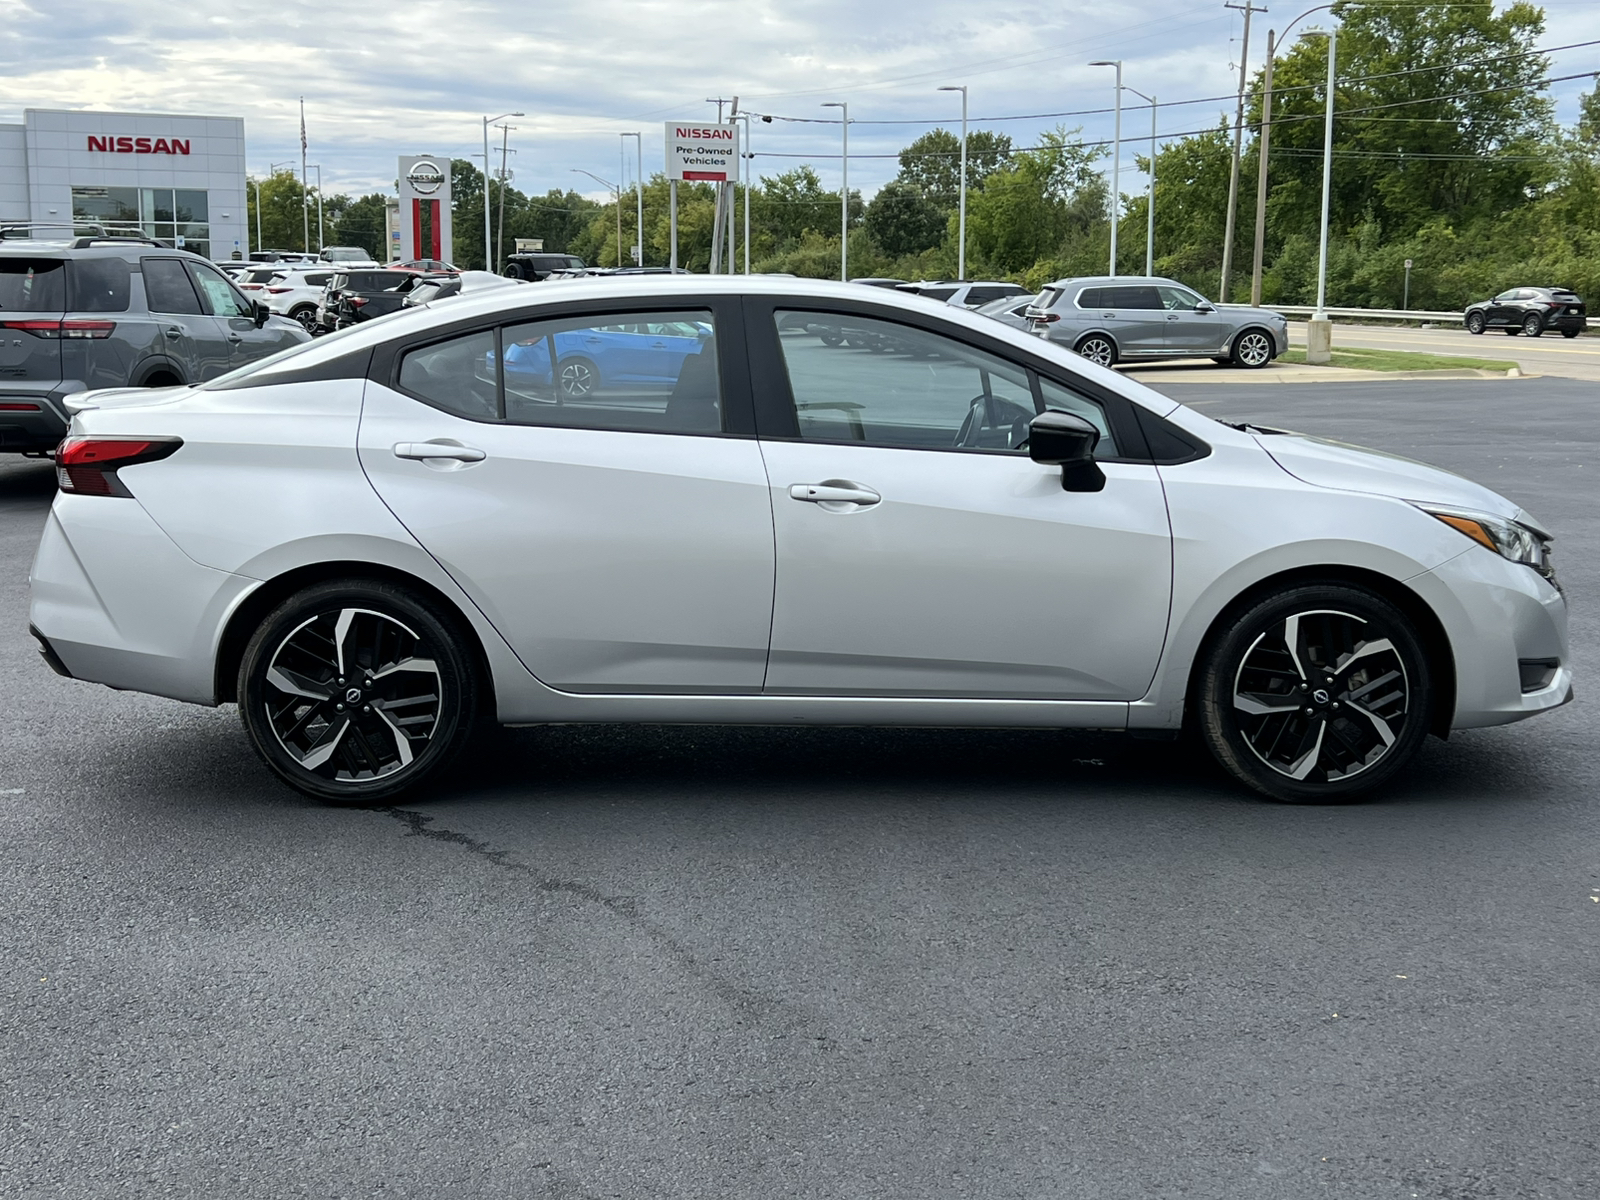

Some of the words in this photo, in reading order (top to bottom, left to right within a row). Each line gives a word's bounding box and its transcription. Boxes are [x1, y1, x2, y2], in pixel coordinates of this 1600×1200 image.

[676, 128, 733, 139] NISSAN
[87, 136, 190, 155] NISSAN
[676, 146, 732, 155] Pre-Owned
[683, 157, 726, 165] Vehicles
